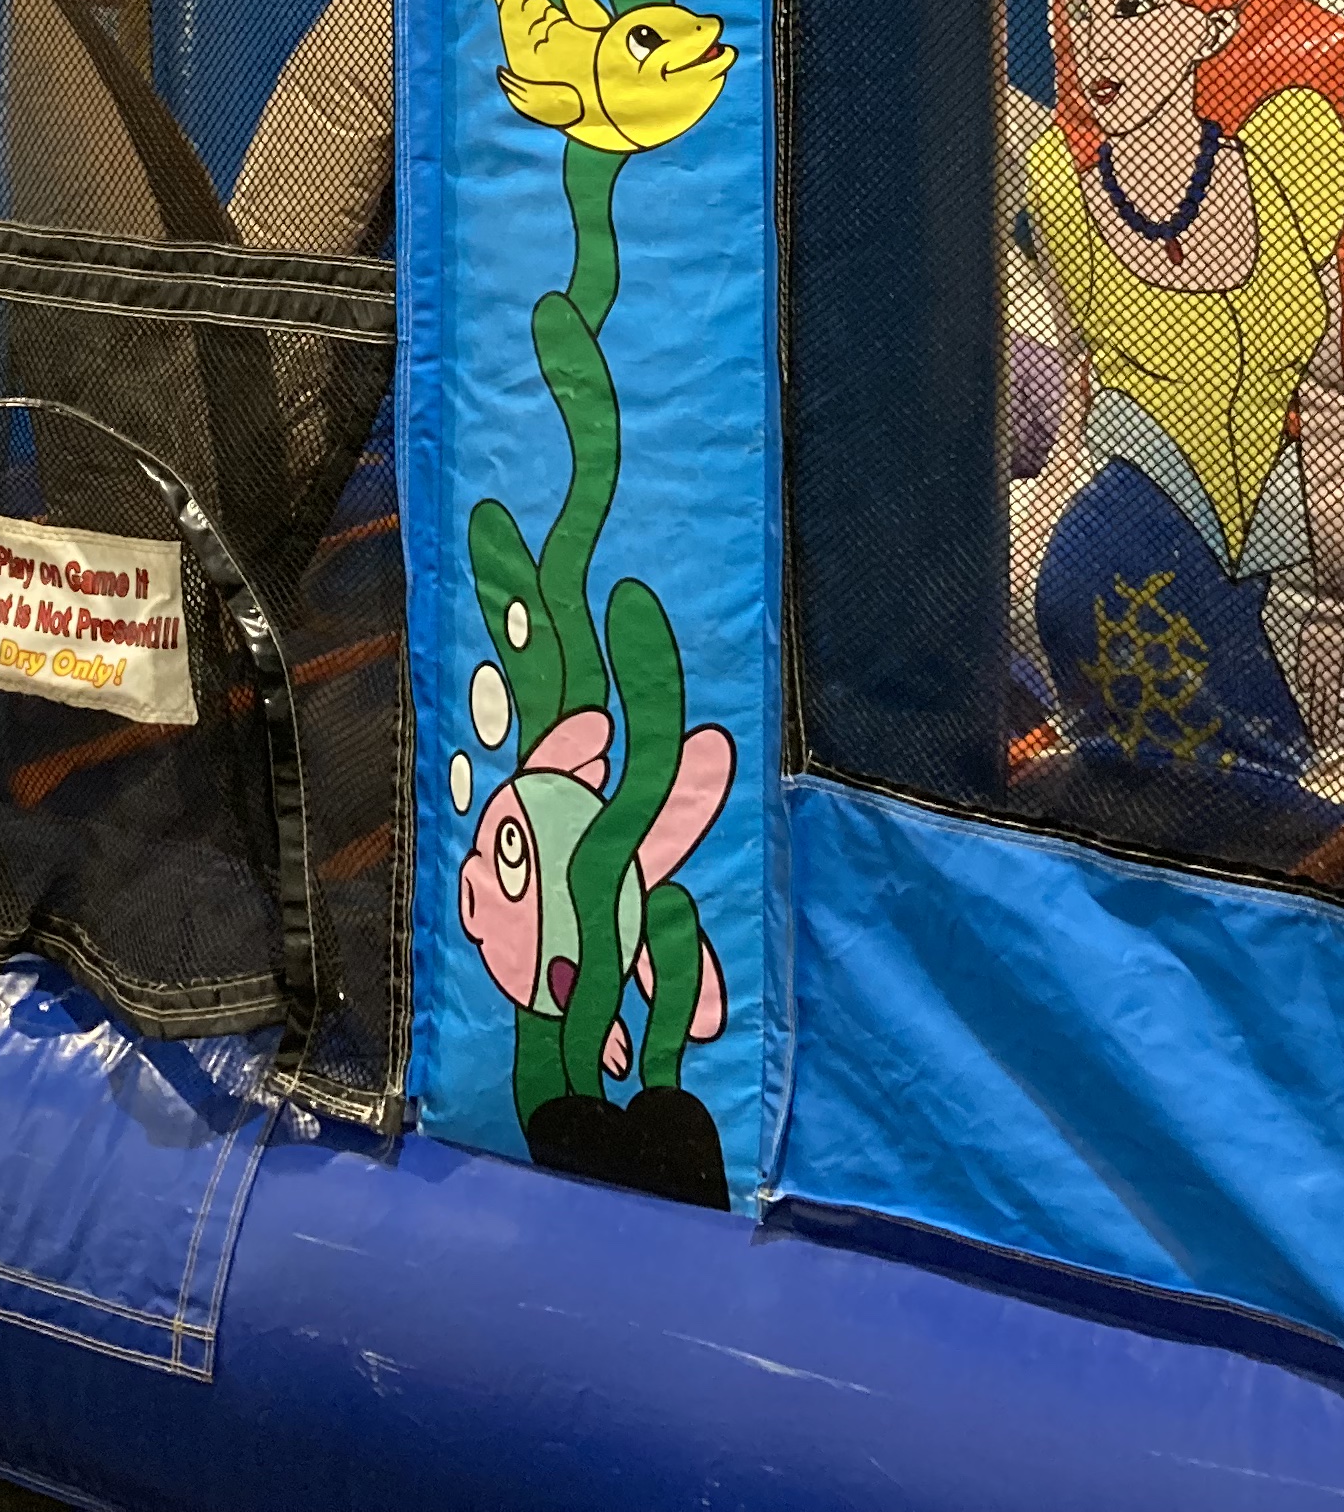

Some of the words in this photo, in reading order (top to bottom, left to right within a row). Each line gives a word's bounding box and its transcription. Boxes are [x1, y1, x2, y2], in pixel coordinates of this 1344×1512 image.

[40, 561, 62, 588] on
[65, 560, 129, 597] Game
[35, 600, 72, 637] Not
[0, 638, 46, 676] Dry
[52, 648, 127, 688] Only!
